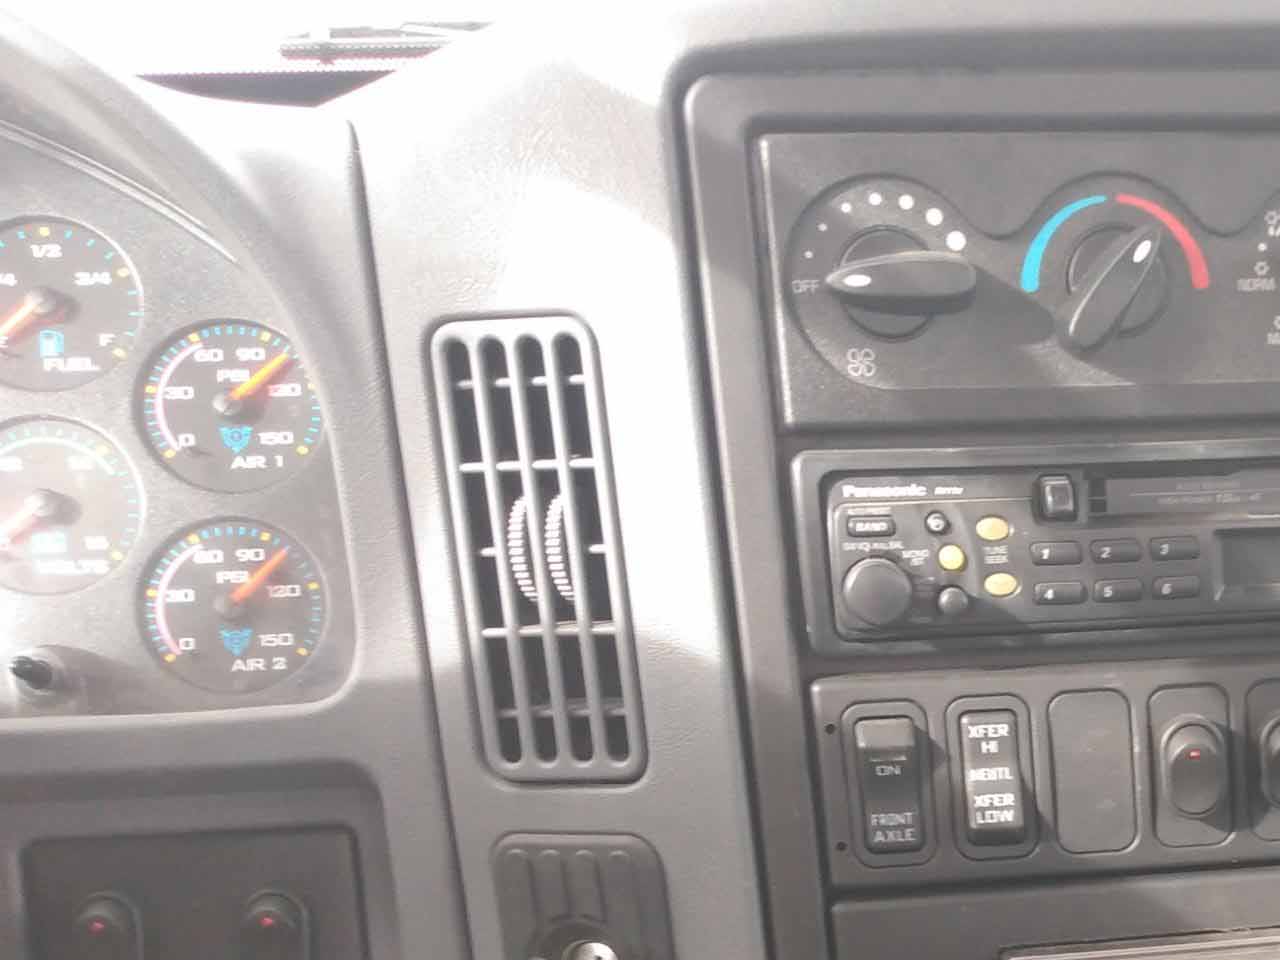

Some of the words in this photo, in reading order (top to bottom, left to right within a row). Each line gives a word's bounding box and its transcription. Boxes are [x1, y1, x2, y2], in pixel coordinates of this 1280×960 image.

[791, 279, 820, 294] OFF
[98, 333, 117, 347] F
[194, 349, 224, 363] 60
[235, 348, 266, 362] 90
[42, 356, 101, 371] FUEL
[164, 387, 195, 401] 30
[178, 433, 196, 447] 0
[258, 431, 294, 446] 150
[230, 456, 267, 470] AIR
[274, 455, 284, 469] 1
[842, 483, 928, 498] Panasonic
[854, 522, 889, 533] BAND
[194, 549, 224, 564] 60
[235, 548, 266, 562] 90
[1040, 549, 1051, 560] 1
[1100, 547, 1112, 559] 2
[1159, 544, 1170, 555] 3
[215, 570, 249, 584] PSI
[165, 588, 196, 602] 30
[265, 583, 301, 598] 120
[1043, 589, 1055, 600] 4
[1103, 586, 1114, 599] 5
[1161, 583, 1173, 596] 6
[178, 637, 196, 651] 0
[258, 633, 294, 647] 150
[230, 658, 267, 672] AIR
[272, 657, 288, 671] 2
[967, 723, 1010, 739] XFER
[980, 741, 1000, 753] HI
[874, 764, 902, 776] ON
[973, 792, 1015, 808] XFER
[870, 812, 914, 827] FRONT
[975, 809, 1015, 824] LOW
[872, 828, 917, 843] AXLE
